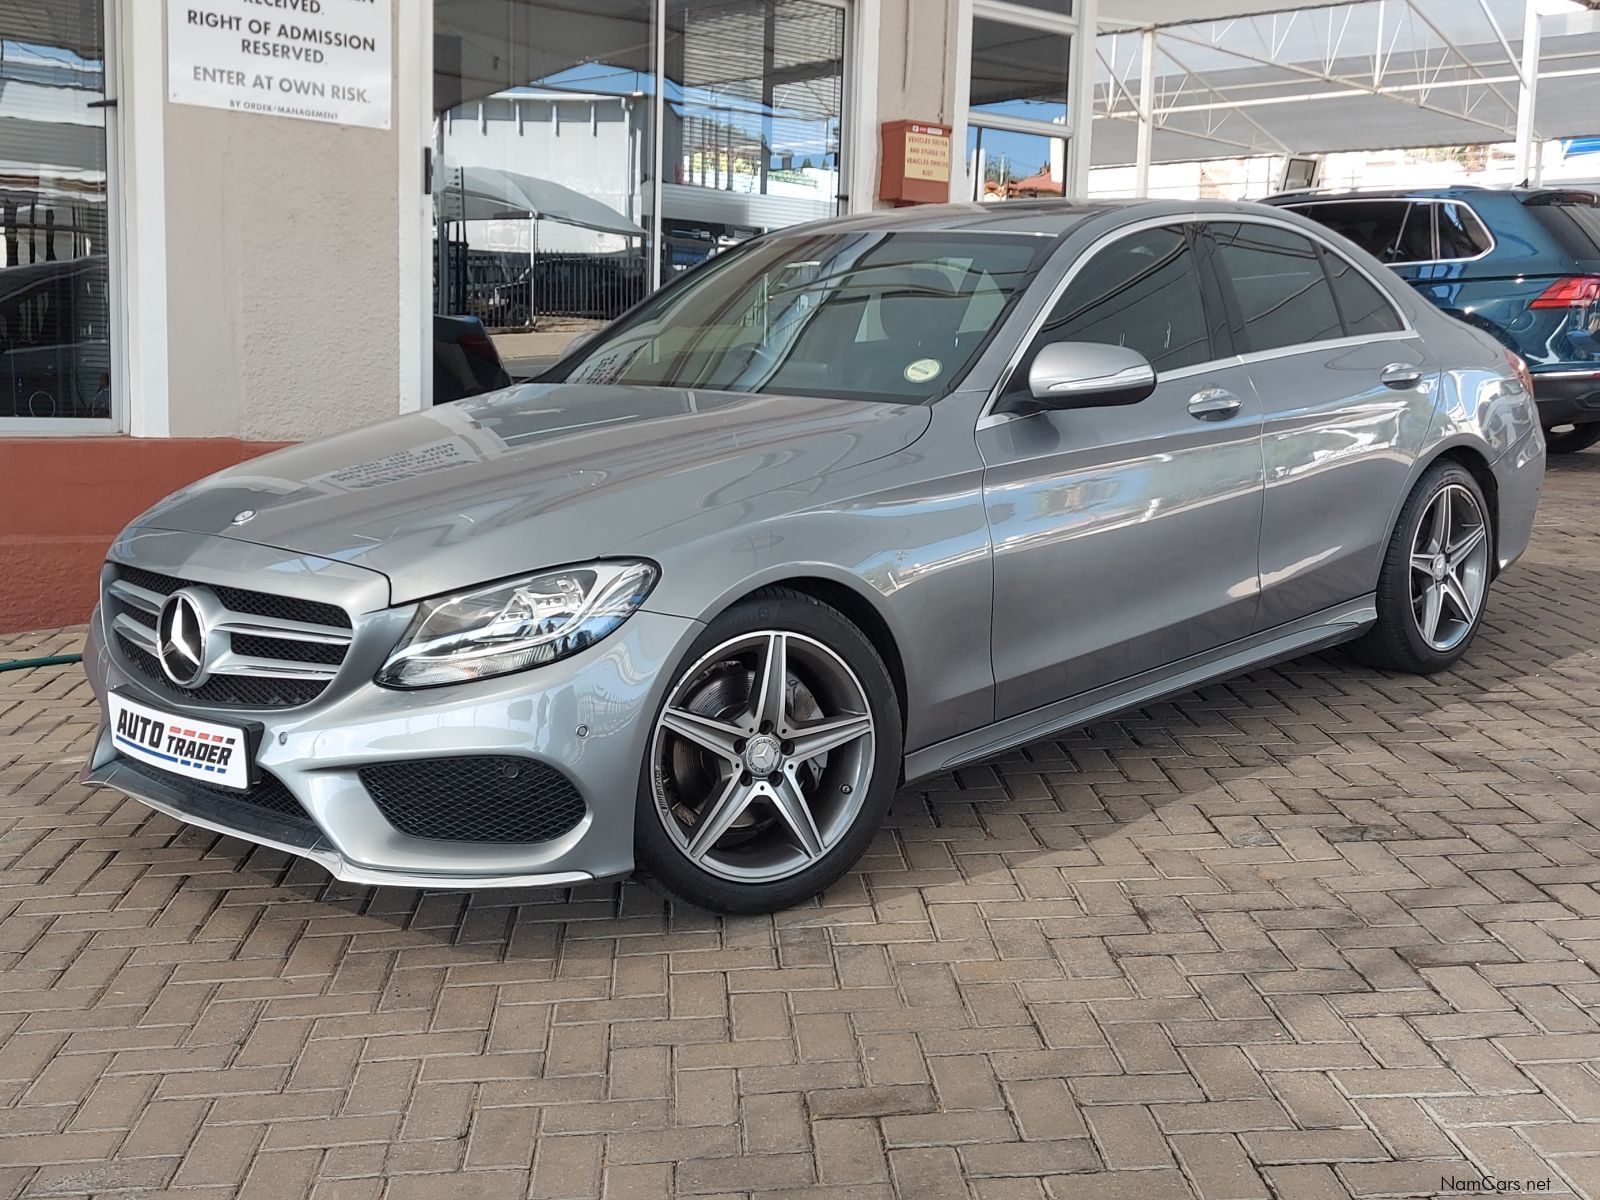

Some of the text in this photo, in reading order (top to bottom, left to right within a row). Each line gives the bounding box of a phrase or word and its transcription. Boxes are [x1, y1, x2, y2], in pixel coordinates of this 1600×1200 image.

[243, 0, 325, 15] EIVED.
[187, 9, 375, 52] RIGHT OF ADMISSION
[241, 39, 328, 65] RESERVED.
[193, 66, 371, 104] ENTER AT OWN RISK.
[229, 99, 241, 108] BY
[276, 105, 338, 120] MANAGEMENT
[116, 708, 165, 749] AUTO
[166, 735, 232, 766] TRADER
